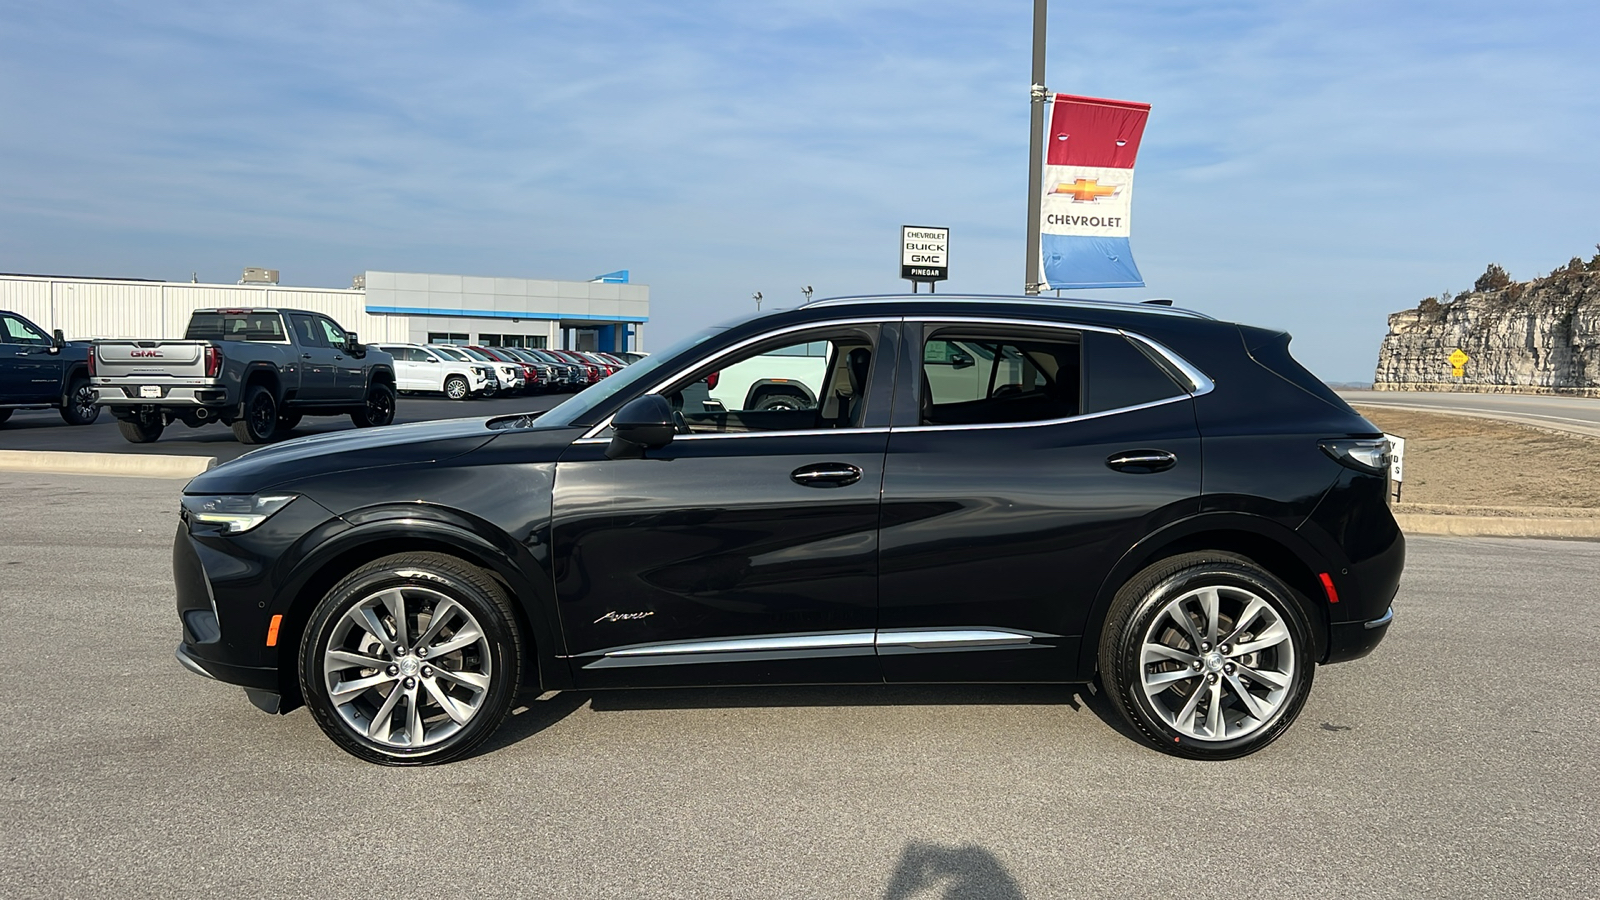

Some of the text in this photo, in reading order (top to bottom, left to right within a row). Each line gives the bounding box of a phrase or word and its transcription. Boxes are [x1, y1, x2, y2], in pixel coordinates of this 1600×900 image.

[1047, 213, 1122, 228] CHEVROLET
[907, 231, 946, 240] CHEVROLET
[906, 243, 945, 252] BUICK
[911, 255, 940, 263] GMC
[130, 350, 164, 358] GMC
